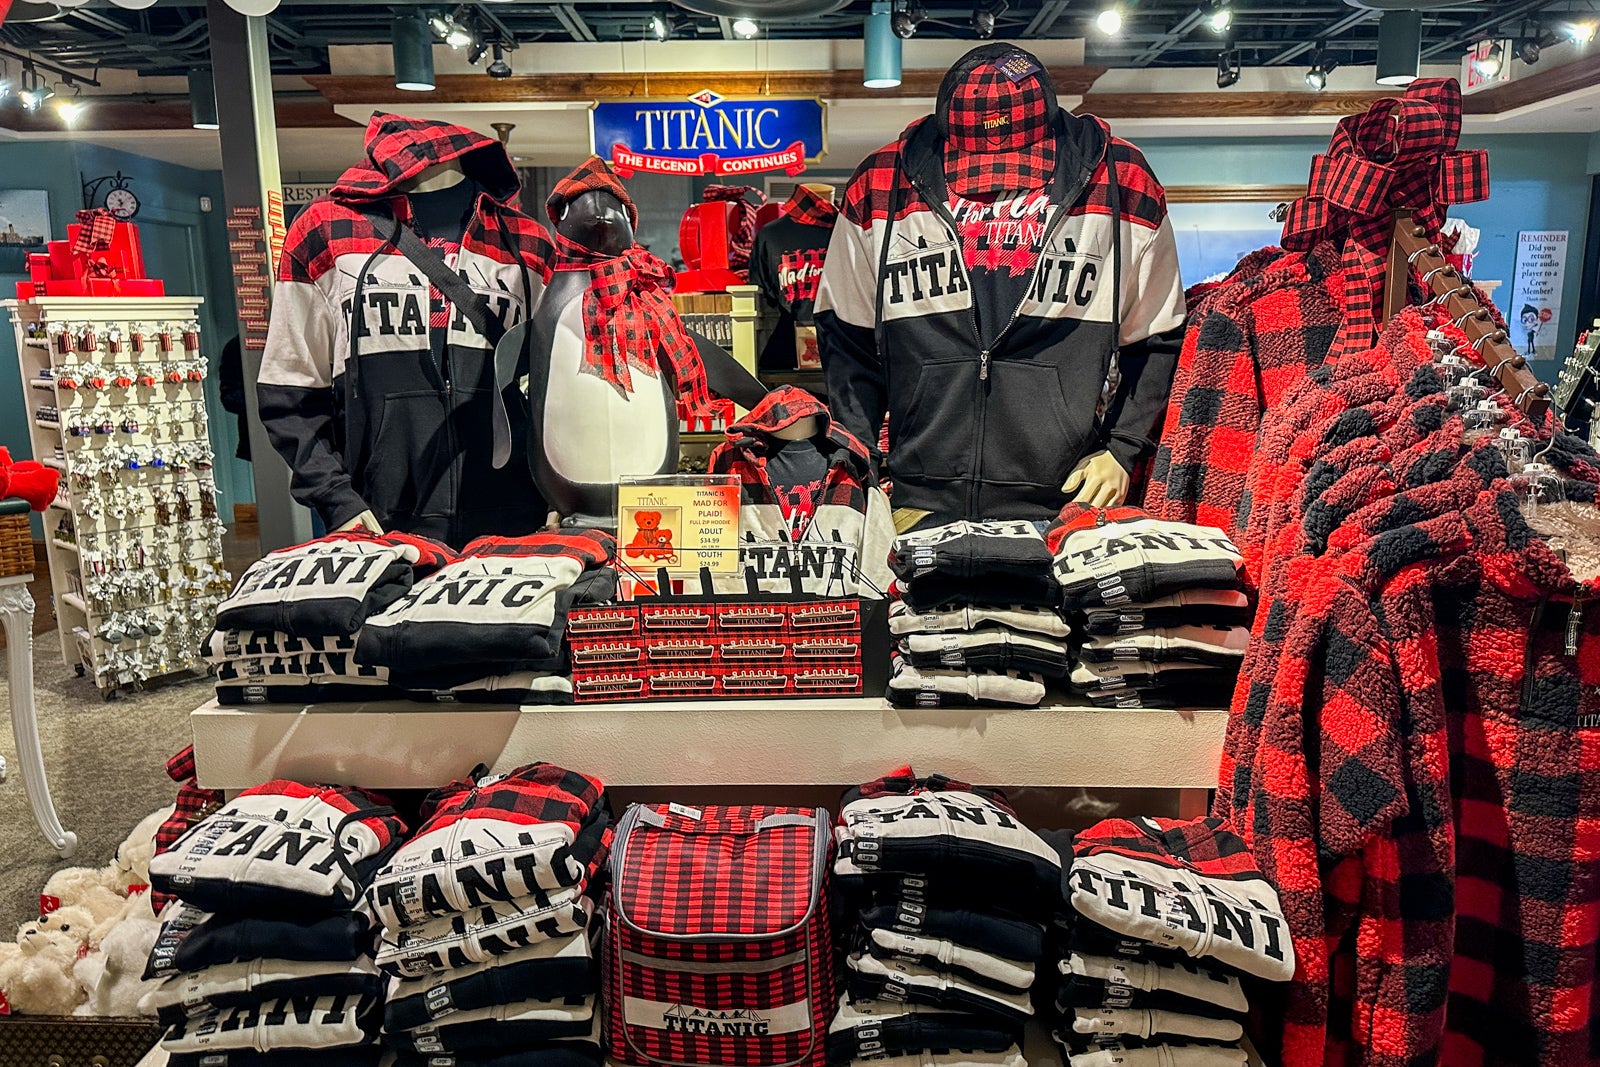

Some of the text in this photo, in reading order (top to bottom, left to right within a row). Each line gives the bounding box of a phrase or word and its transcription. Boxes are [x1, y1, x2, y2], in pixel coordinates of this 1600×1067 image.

[983, 115, 1009, 130] TITANIC
[635, 108, 780, 150] TITANIC
[617, 152, 797, 172] THE LEGEND CONTINUES
[962, 202, 991, 226] for
[1520, 233, 1567, 243] REMINDER
[778, 262, 809, 291] Mad
[1521, 270, 1543, 279] player
[1521, 288, 1554, 296] Member?
[637, 497, 668, 506] TITANIC
[698, 510, 723, 518] PLAID!
[696, 551, 723, 559] YOUTH
[1099, 577, 1120, 587] Medium
[1103, 587, 1124, 596] Medium
[808, 616, 842, 624] TITANIC
[587, 622, 620, 630] TITANIC
[809, 648, 843, 656] TITANIC
[592, 653, 626, 661] TITANIC
[667, 681, 700, 689] TITANIC
[810, 679, 844, 687] TITANIC
[595, 684, 628, 692] TITANIC
[185, 855, 202, 863] Large
[404, 855, 421, 863] Large
[179, 865, 196, 873] Large
[174, 875, 192, 884] Large
[400, 874, 416, 882] Large
[400, 886, 417, 894] Large
[405, 907, 423, 915] Large
[904, 914, 915, 922] Large
[1162, 932, 1174, 940] Large
[406, 939, 424, 947] Large
[902, 945, 914, 954] Large
[154, 958, 172, 967] Large
[895, 962, 907, 971] Large
[893, 973, 904, 982] Large
[432, 988, 442, 996] Large
[663, 1014, 769, 1036] TITANIC
